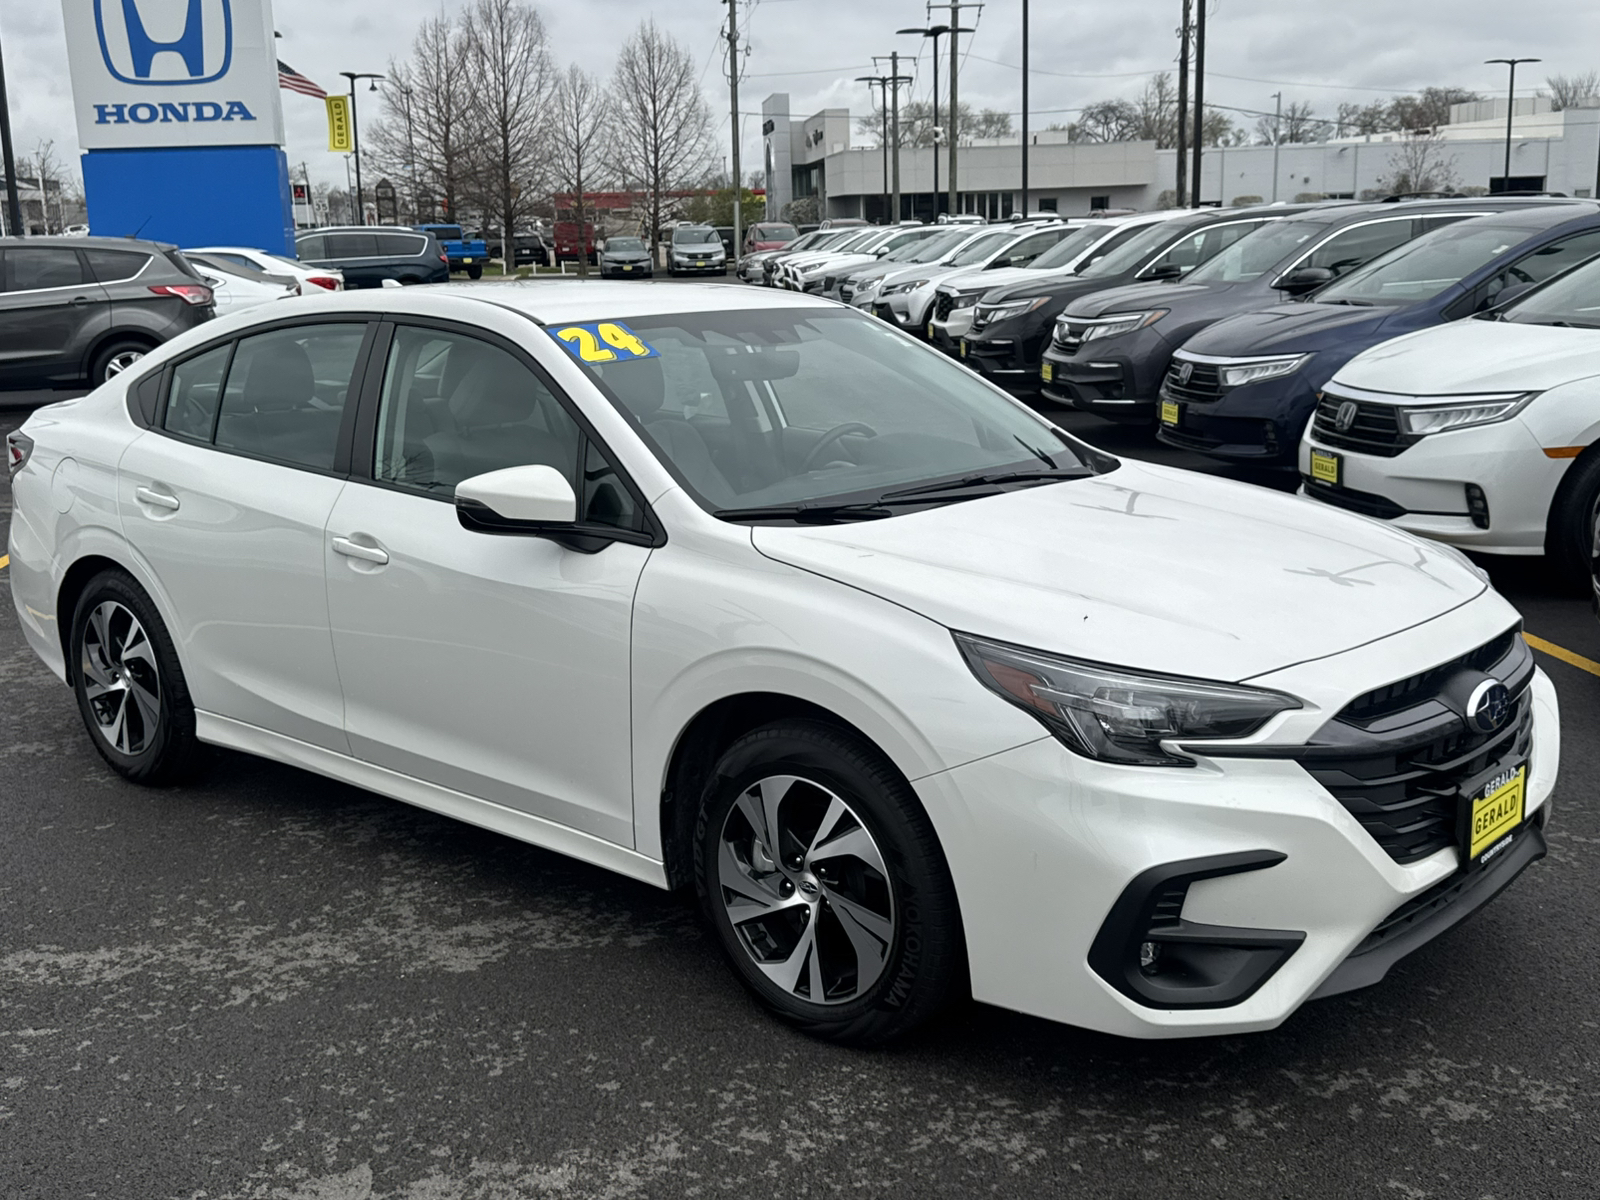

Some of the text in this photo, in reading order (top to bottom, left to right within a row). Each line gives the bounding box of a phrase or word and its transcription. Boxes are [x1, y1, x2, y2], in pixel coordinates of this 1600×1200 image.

[93, 101, 257, 124] HONDA
[334, 102, 345, 145] GERALD
[315, 203, 328, 211] 35
[557, 323, 651, 362] 24
[1314, 461, 1335, 474] GERALD
[1484, 767, 1517, 798] GERALD
[1475, 794, 1516, 835] GERALD
[884, 895, 922, 1008] YOKOHAMA
